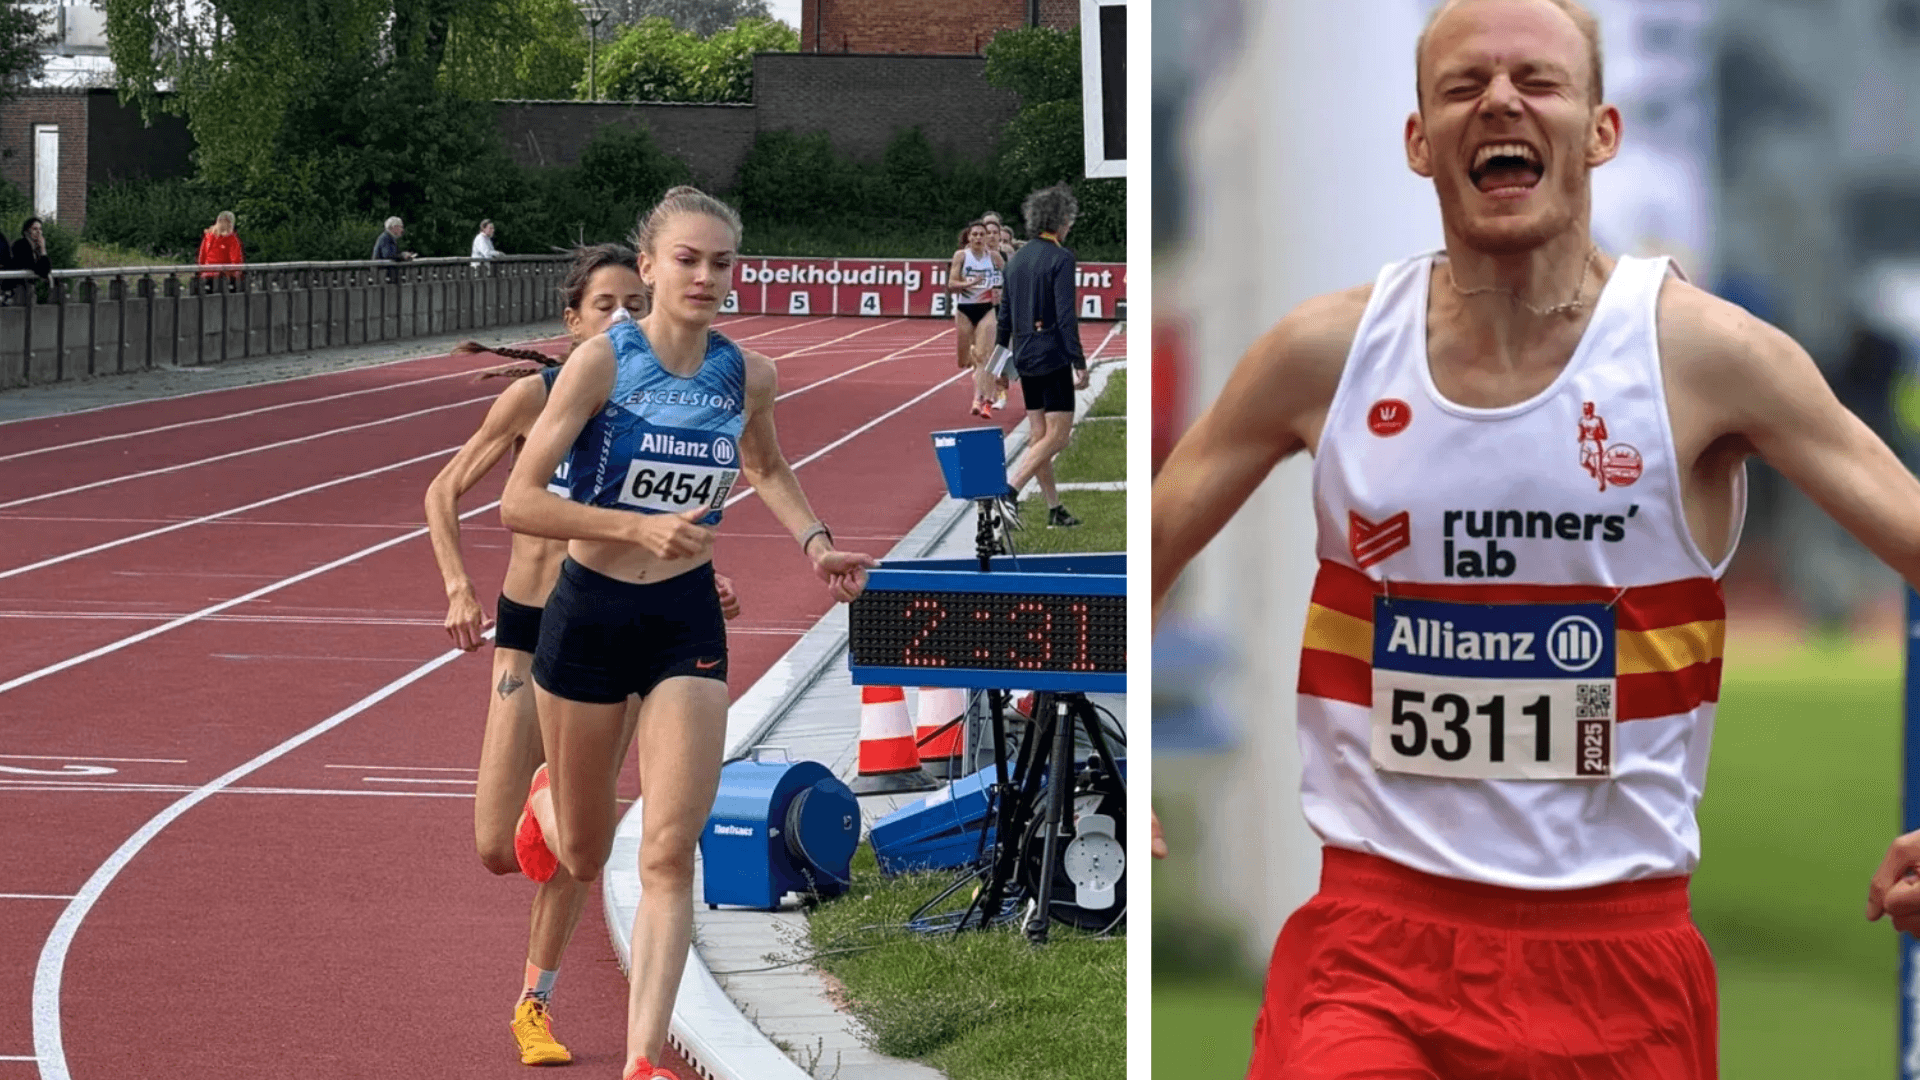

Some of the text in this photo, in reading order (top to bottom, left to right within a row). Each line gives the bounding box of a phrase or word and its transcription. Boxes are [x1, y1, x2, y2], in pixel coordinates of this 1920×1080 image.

[741, 263, 921, 292] boekhouding
[723, 293, 734, 308] 6
[794, 295, 805, 310] 5
[864, 296, 877, 311] 4
[935, 297, 946, 311] 3
[1086, 299, 1095, 313] 1
[625, 390, 736, 411] EXCELSIOR
[640, 433, 709, 458] Allianz
[631, 468, 714, 505] 6454
[1443, 505, 1639, 542] runners'
[1443, 540, 1516, 578] lab
[1387, 615, 1536, 661] Allianz
[1390, 688, 1551, 762] 5311
[1584, 723, 1603, 771] 2025
